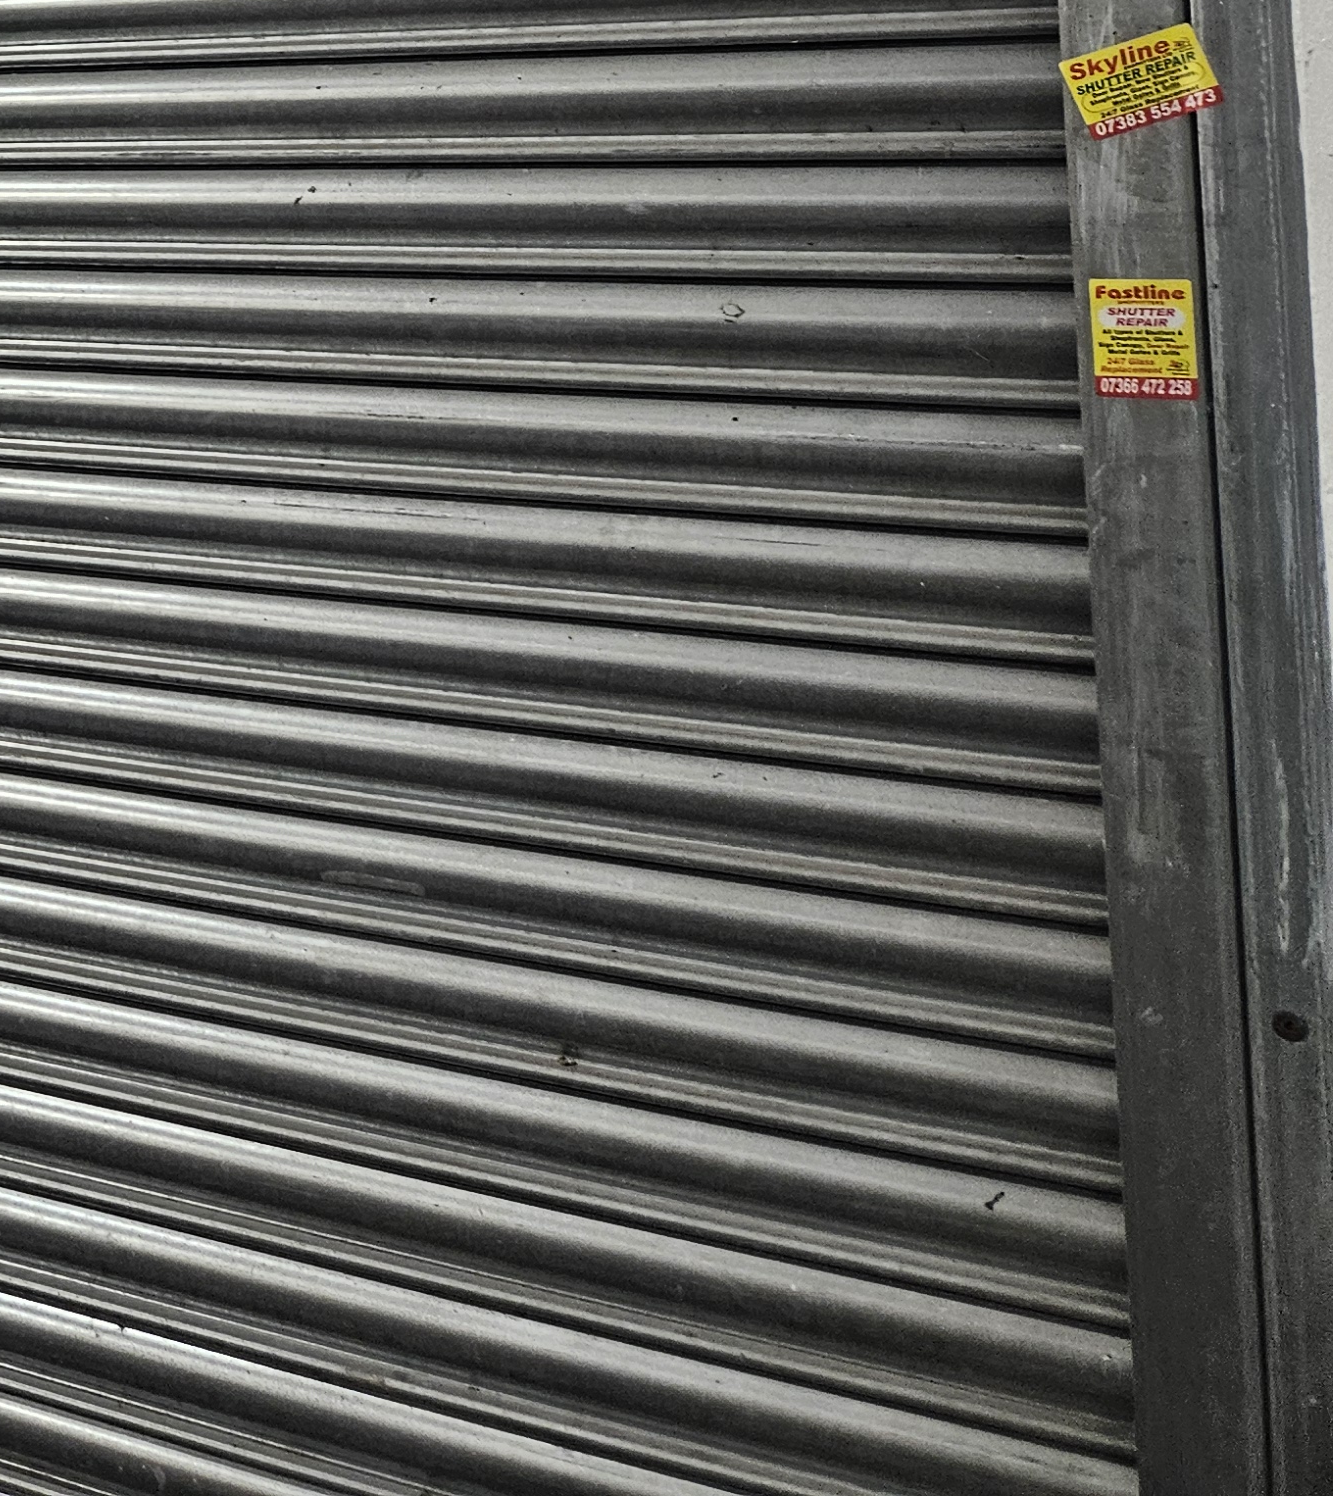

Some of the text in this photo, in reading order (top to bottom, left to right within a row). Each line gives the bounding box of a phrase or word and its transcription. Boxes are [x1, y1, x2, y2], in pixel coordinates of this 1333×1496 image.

[1069, 41, 1171, 81] Skyline
[1076, 68, 1142, 95] SHUTTER
[1145, 51, 1196, 75] REPAIR
[1095, 88, 1217, 136] 07383 554 473
[1095, 285, 1186, 300] Fastline
[1107, 307, 1176, 317] SHUTTER
[1116, 317, 1169, 327] REPAIR
[1100, 378, 1192, 395] 07366 472 258
